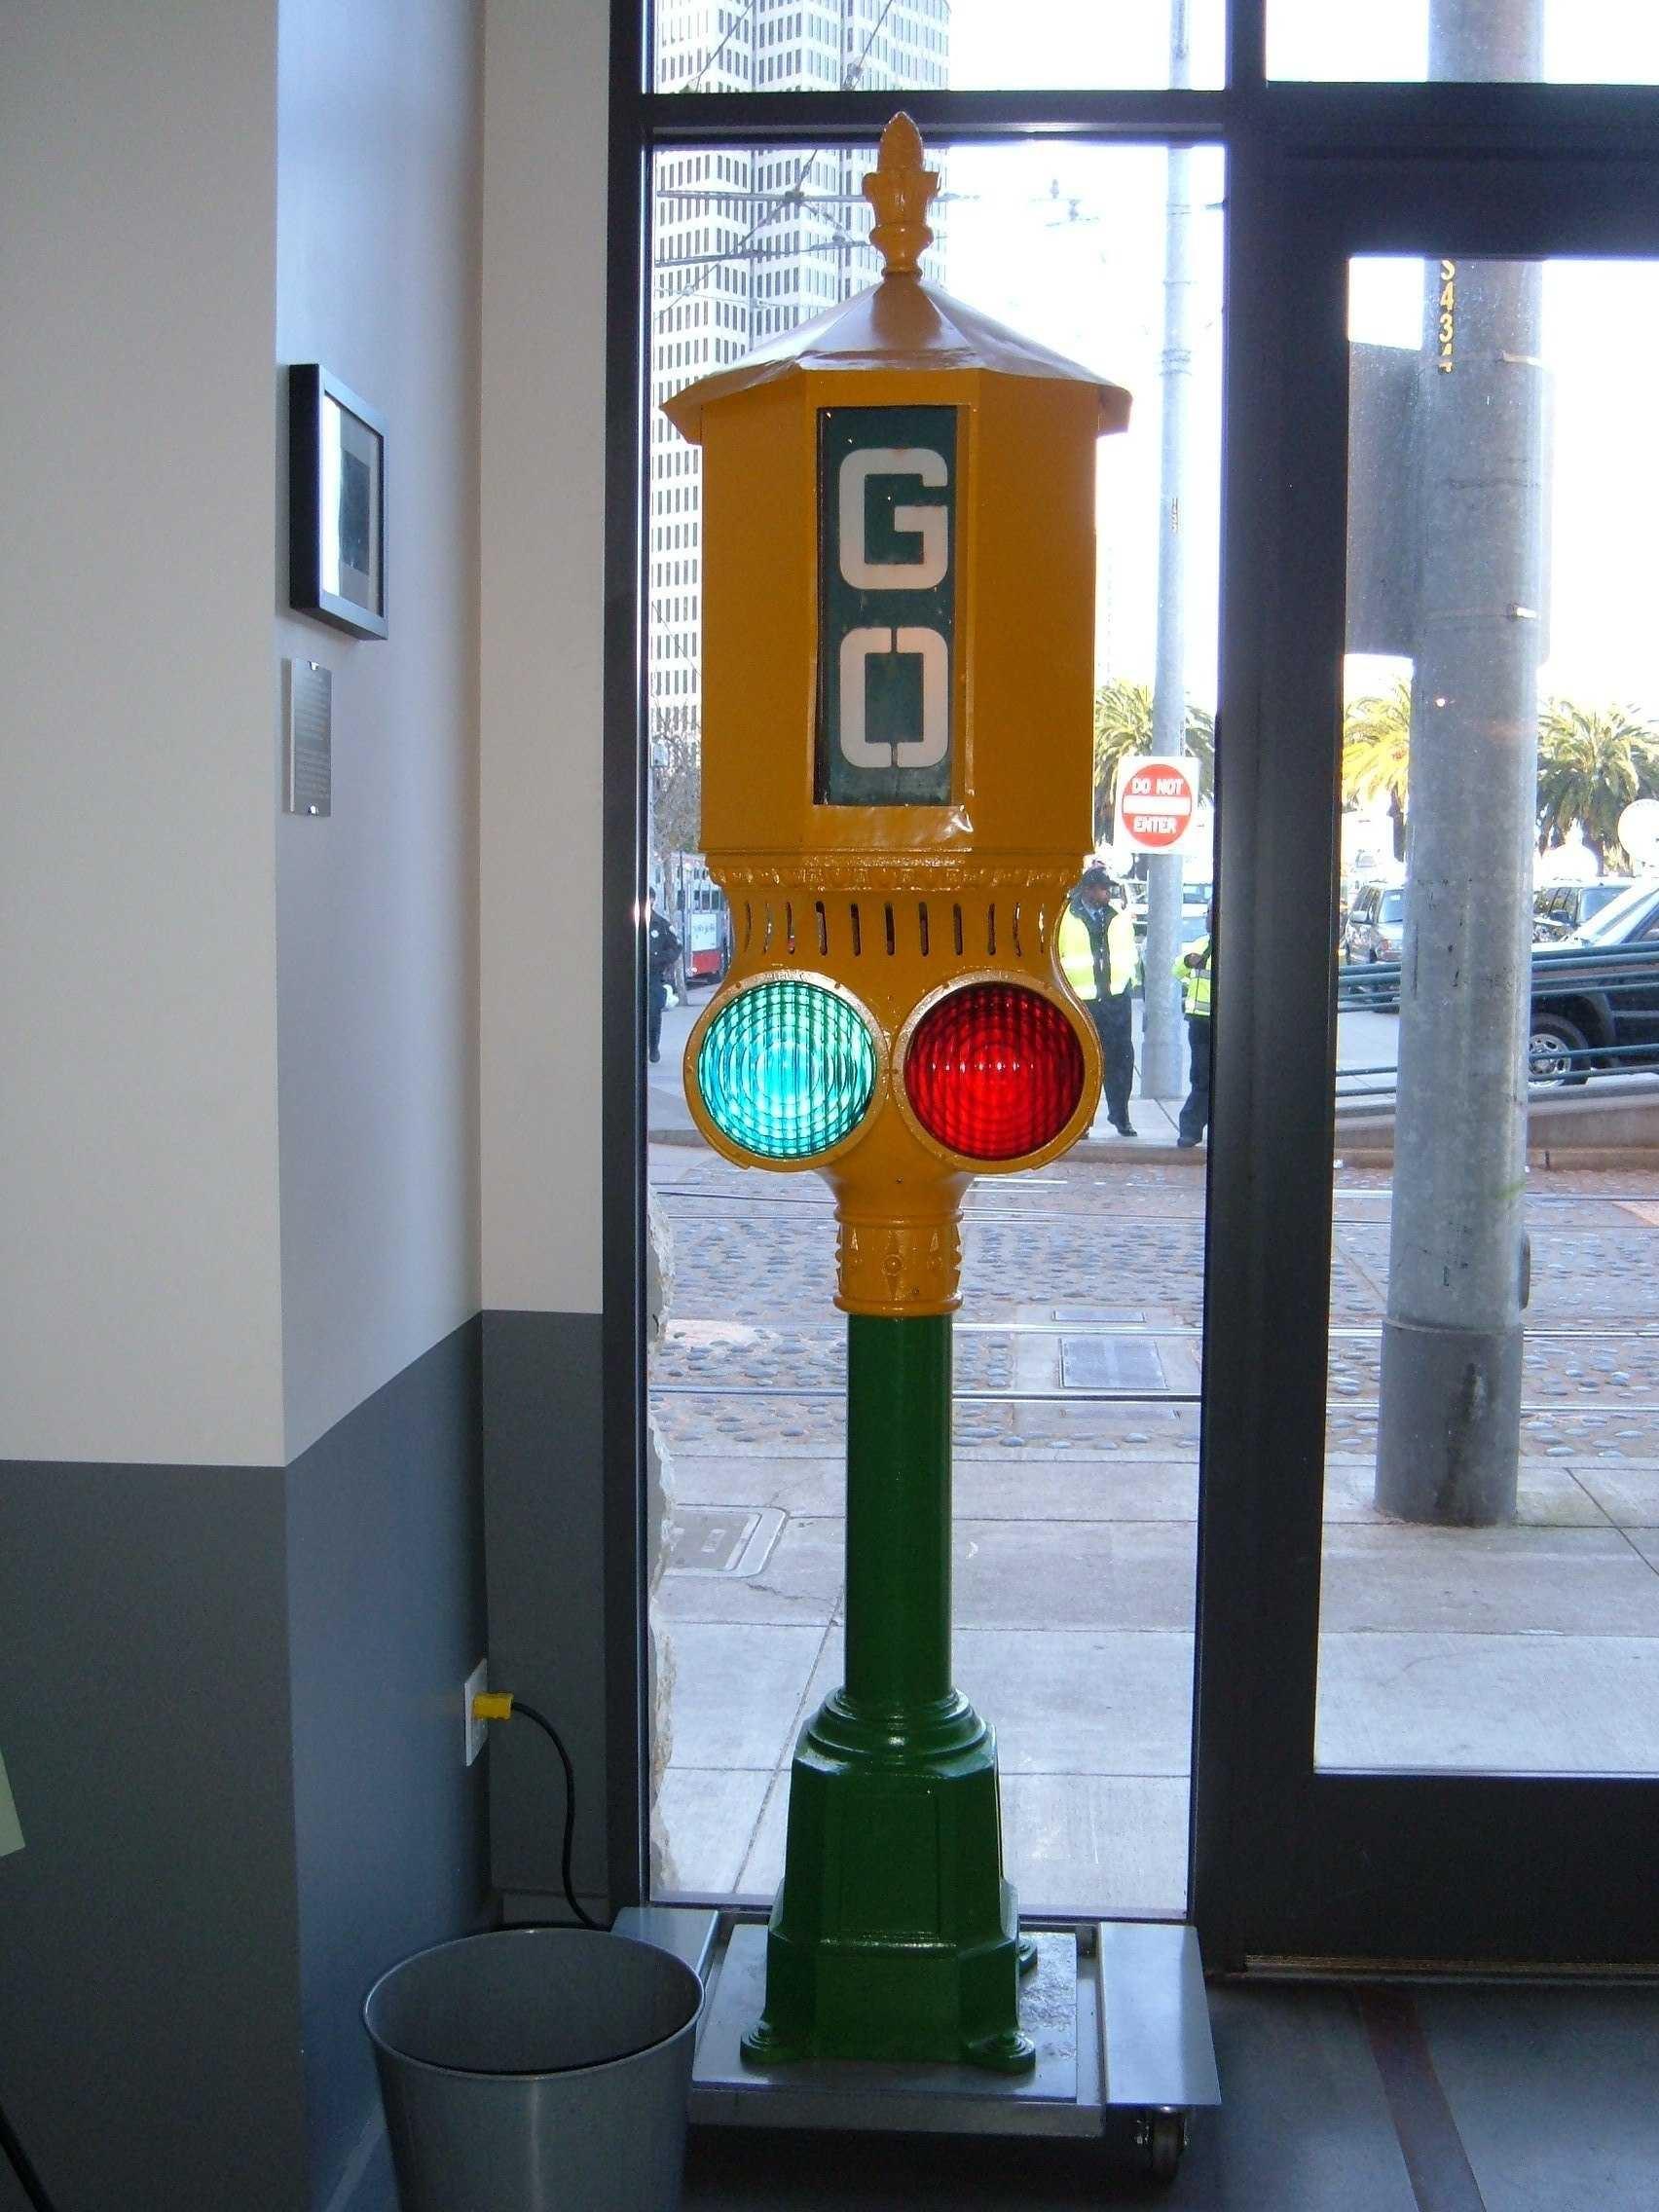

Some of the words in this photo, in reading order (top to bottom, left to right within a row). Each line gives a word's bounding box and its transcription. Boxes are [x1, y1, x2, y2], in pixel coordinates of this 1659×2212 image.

[839, 448, 948, 768] GO
[1131, 778, 1152, 794] DO
[1156, 778, 1184, 795] NOT
[1133, 816, 1177, 833] ENTER
